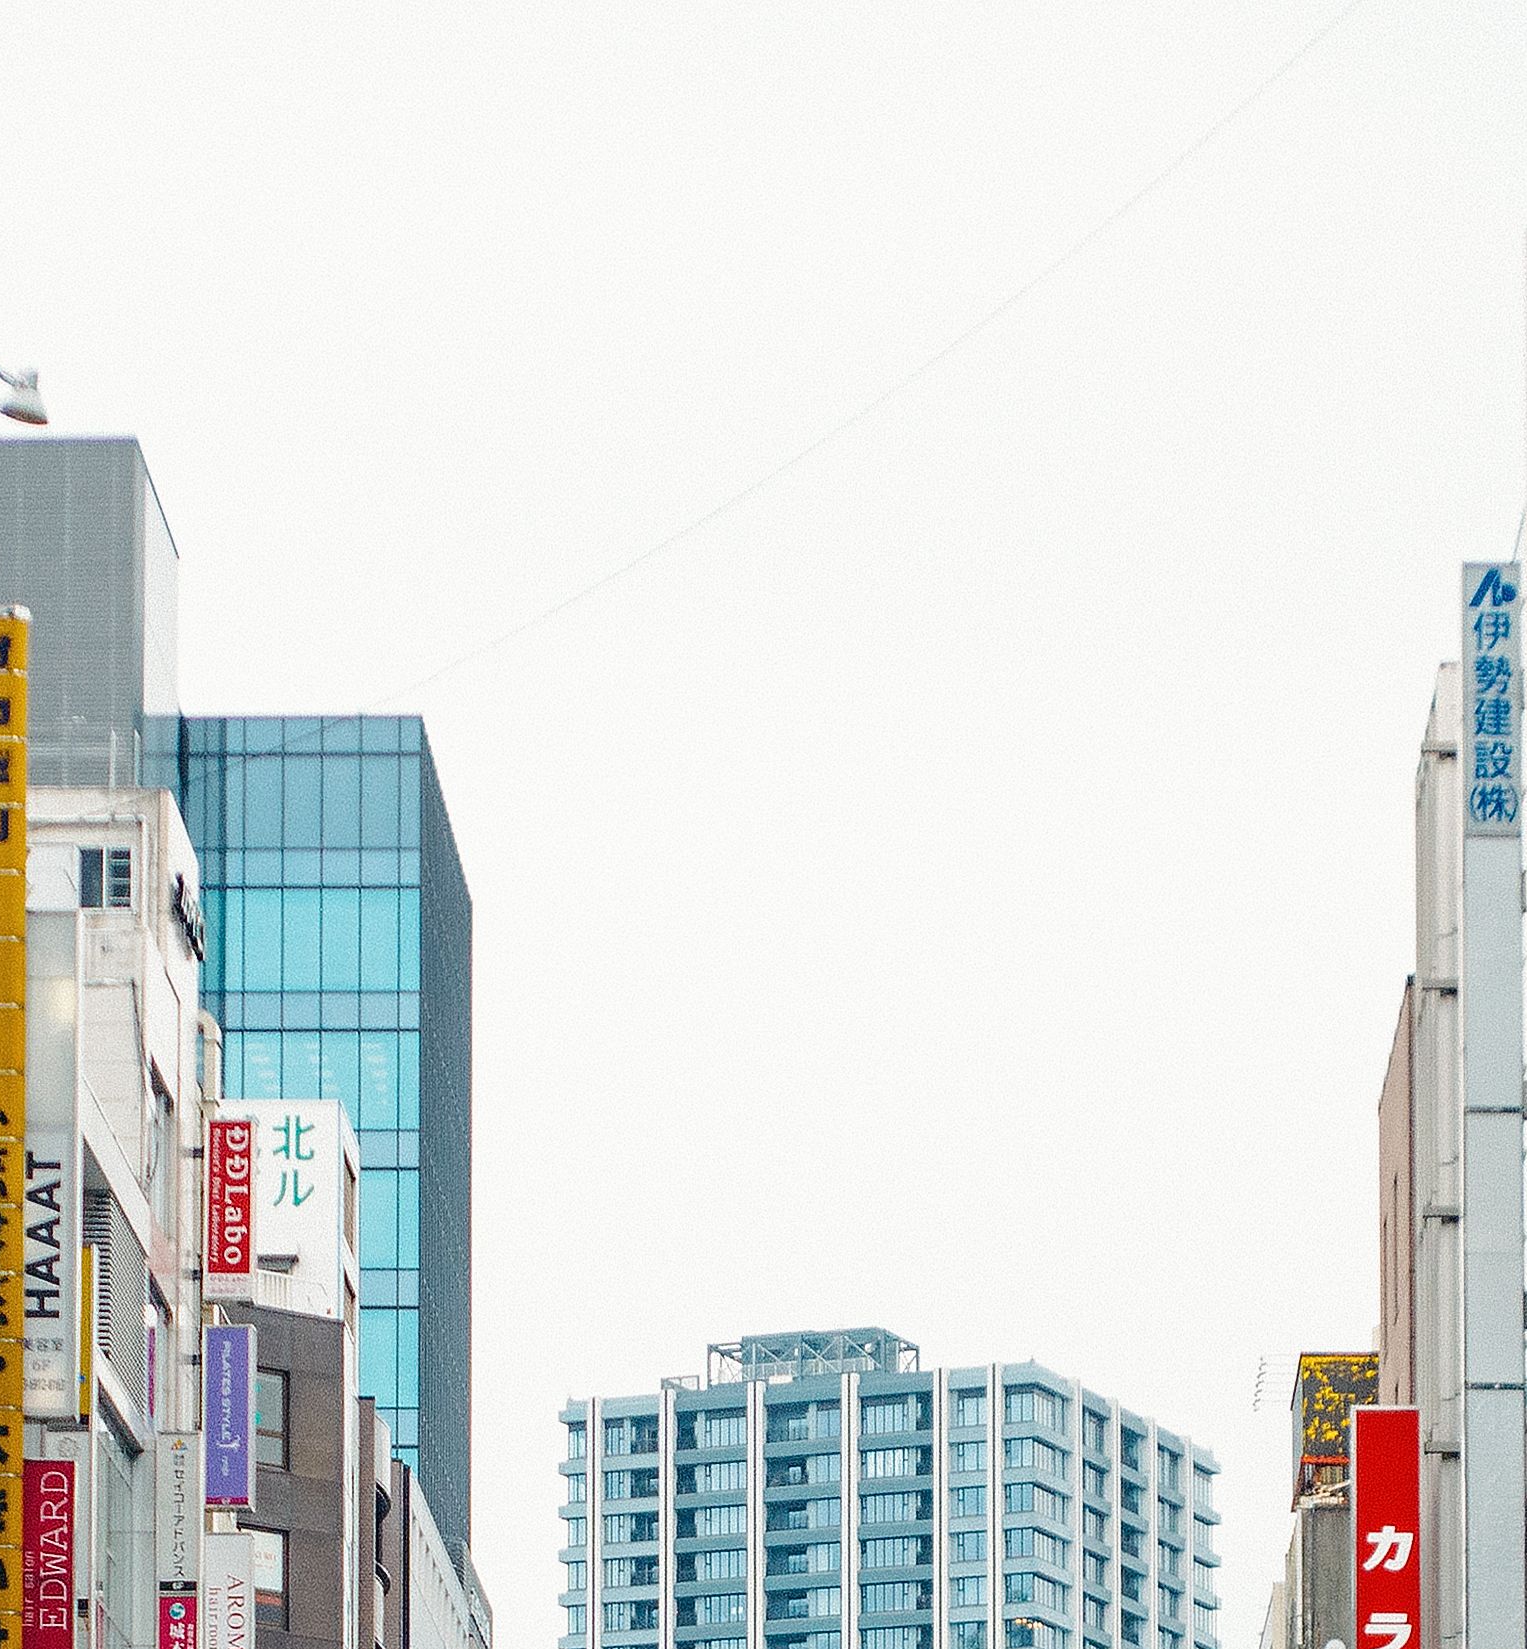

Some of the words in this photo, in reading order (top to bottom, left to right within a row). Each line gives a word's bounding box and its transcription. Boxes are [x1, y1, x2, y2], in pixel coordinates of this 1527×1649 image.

[1468, 611, 1520, 823] 伊勢建設(株)
[24, 1150, 63, 1320] HAAAT
[38, 1470, 70, 1631] EDWARD
